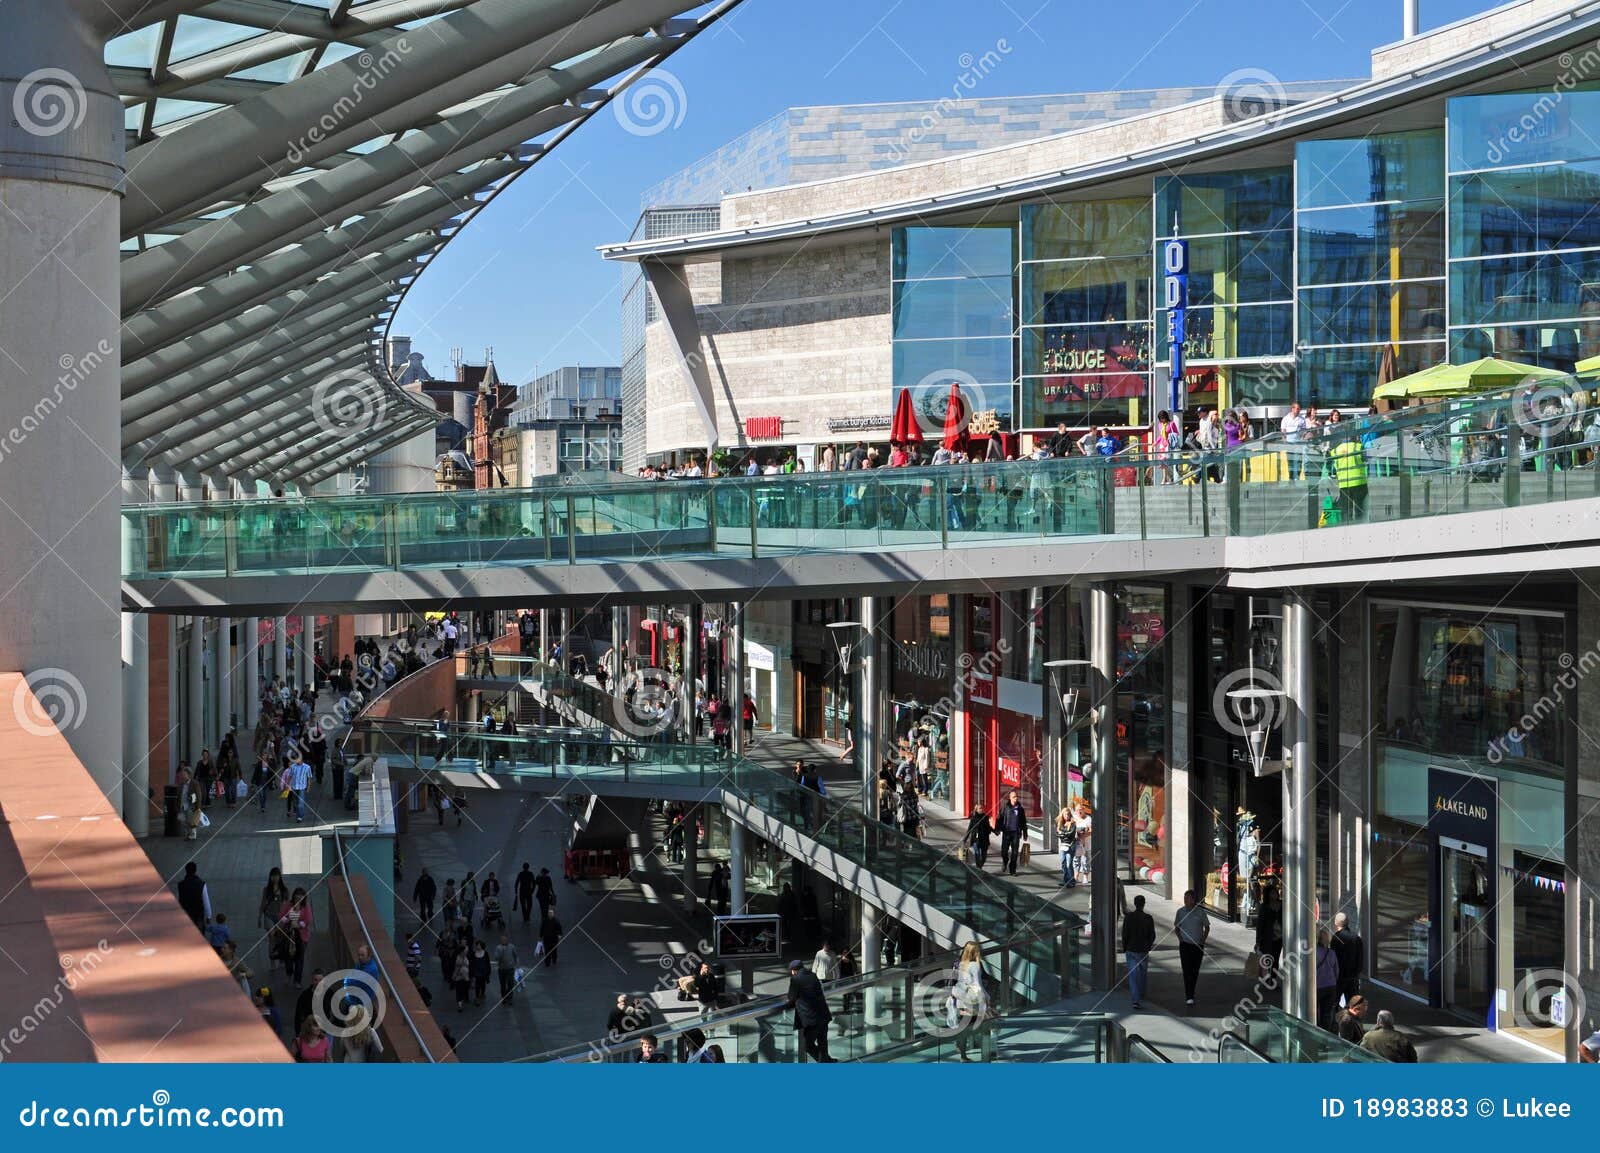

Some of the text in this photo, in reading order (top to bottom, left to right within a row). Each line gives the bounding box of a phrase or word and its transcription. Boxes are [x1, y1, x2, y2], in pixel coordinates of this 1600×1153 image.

[1054, 349, 1106, 371] ROUGE
[1003, 765, 1018, 783] SALE
[1443, 800, 1487, 820] LAKELAND
